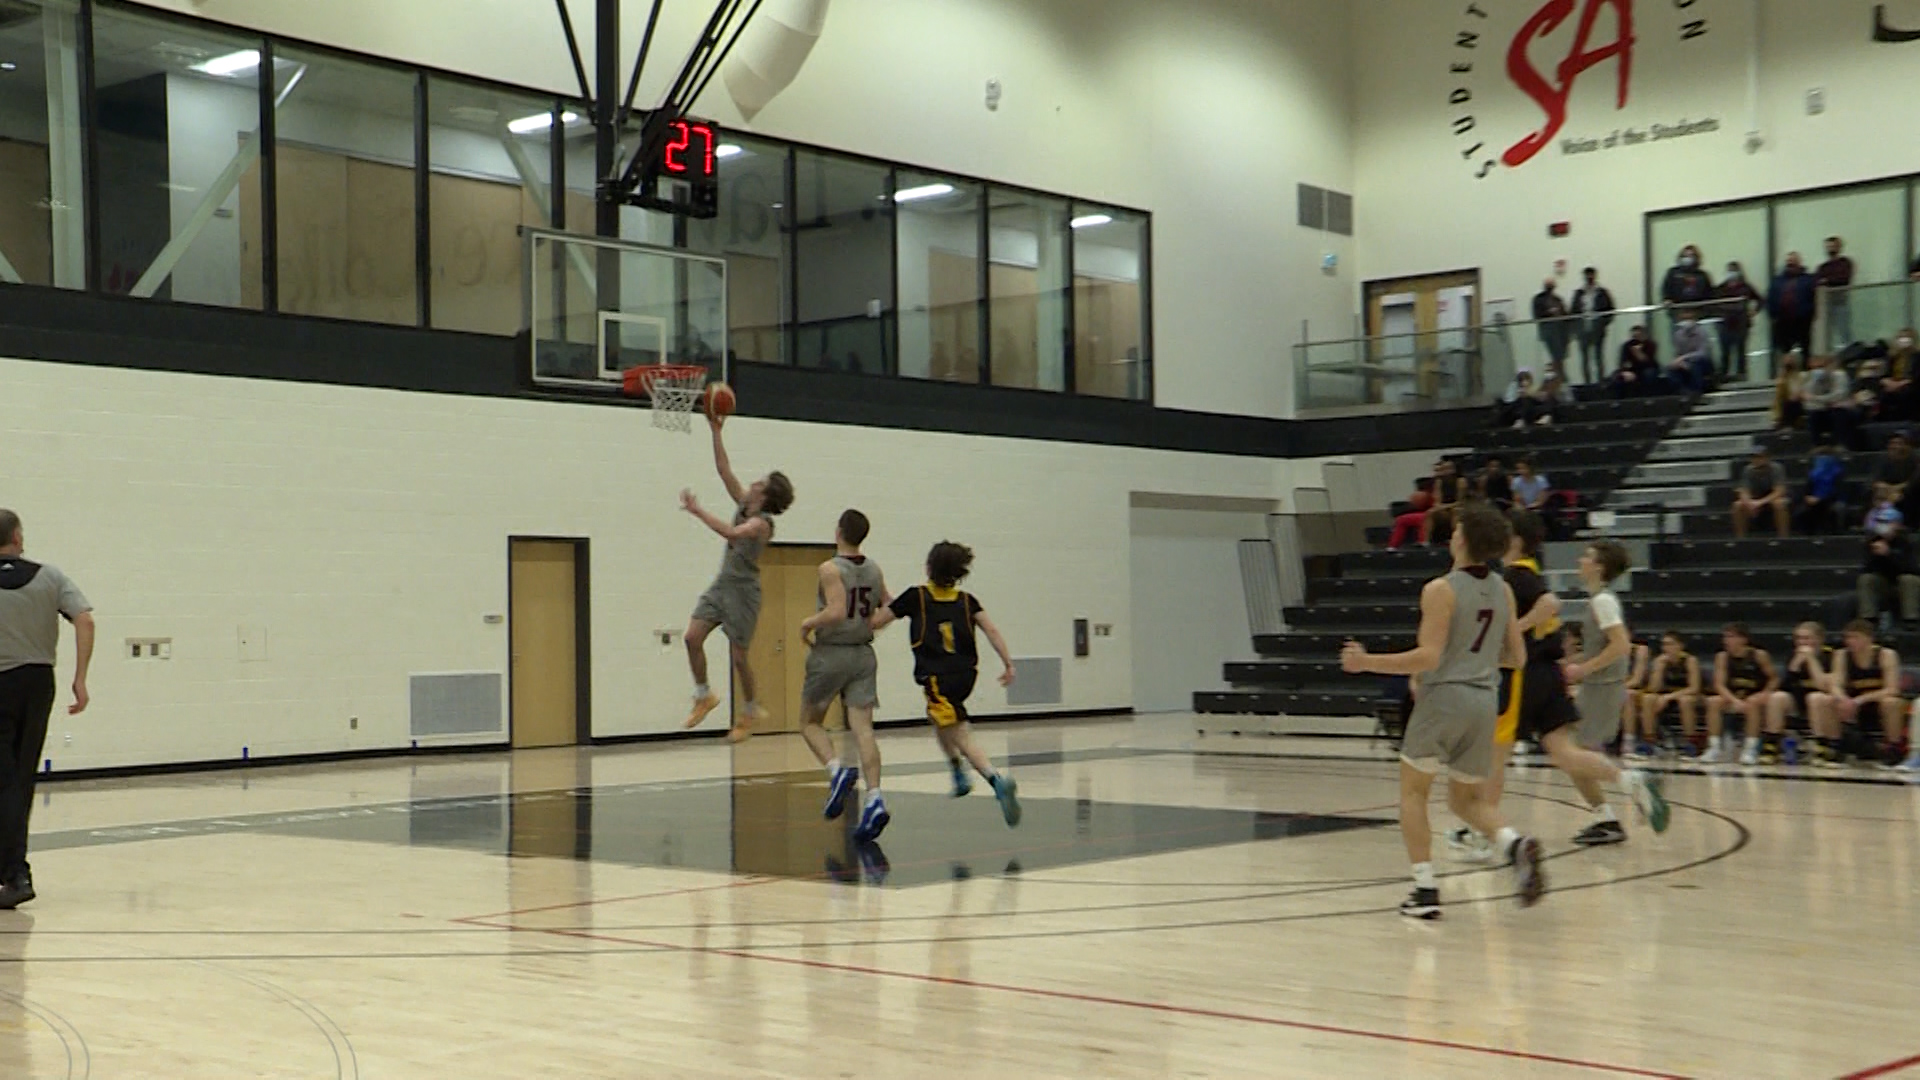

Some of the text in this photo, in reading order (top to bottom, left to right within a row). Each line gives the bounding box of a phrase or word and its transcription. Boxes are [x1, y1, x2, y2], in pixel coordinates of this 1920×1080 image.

[664, 121, 714, 175] 27
[1560, 117, 1720, 155] Voice of the Students
[847, 586, 872, 618] 15
[938, 620, 957, 654] 1
[1470, 608, 1495, 654] 7
